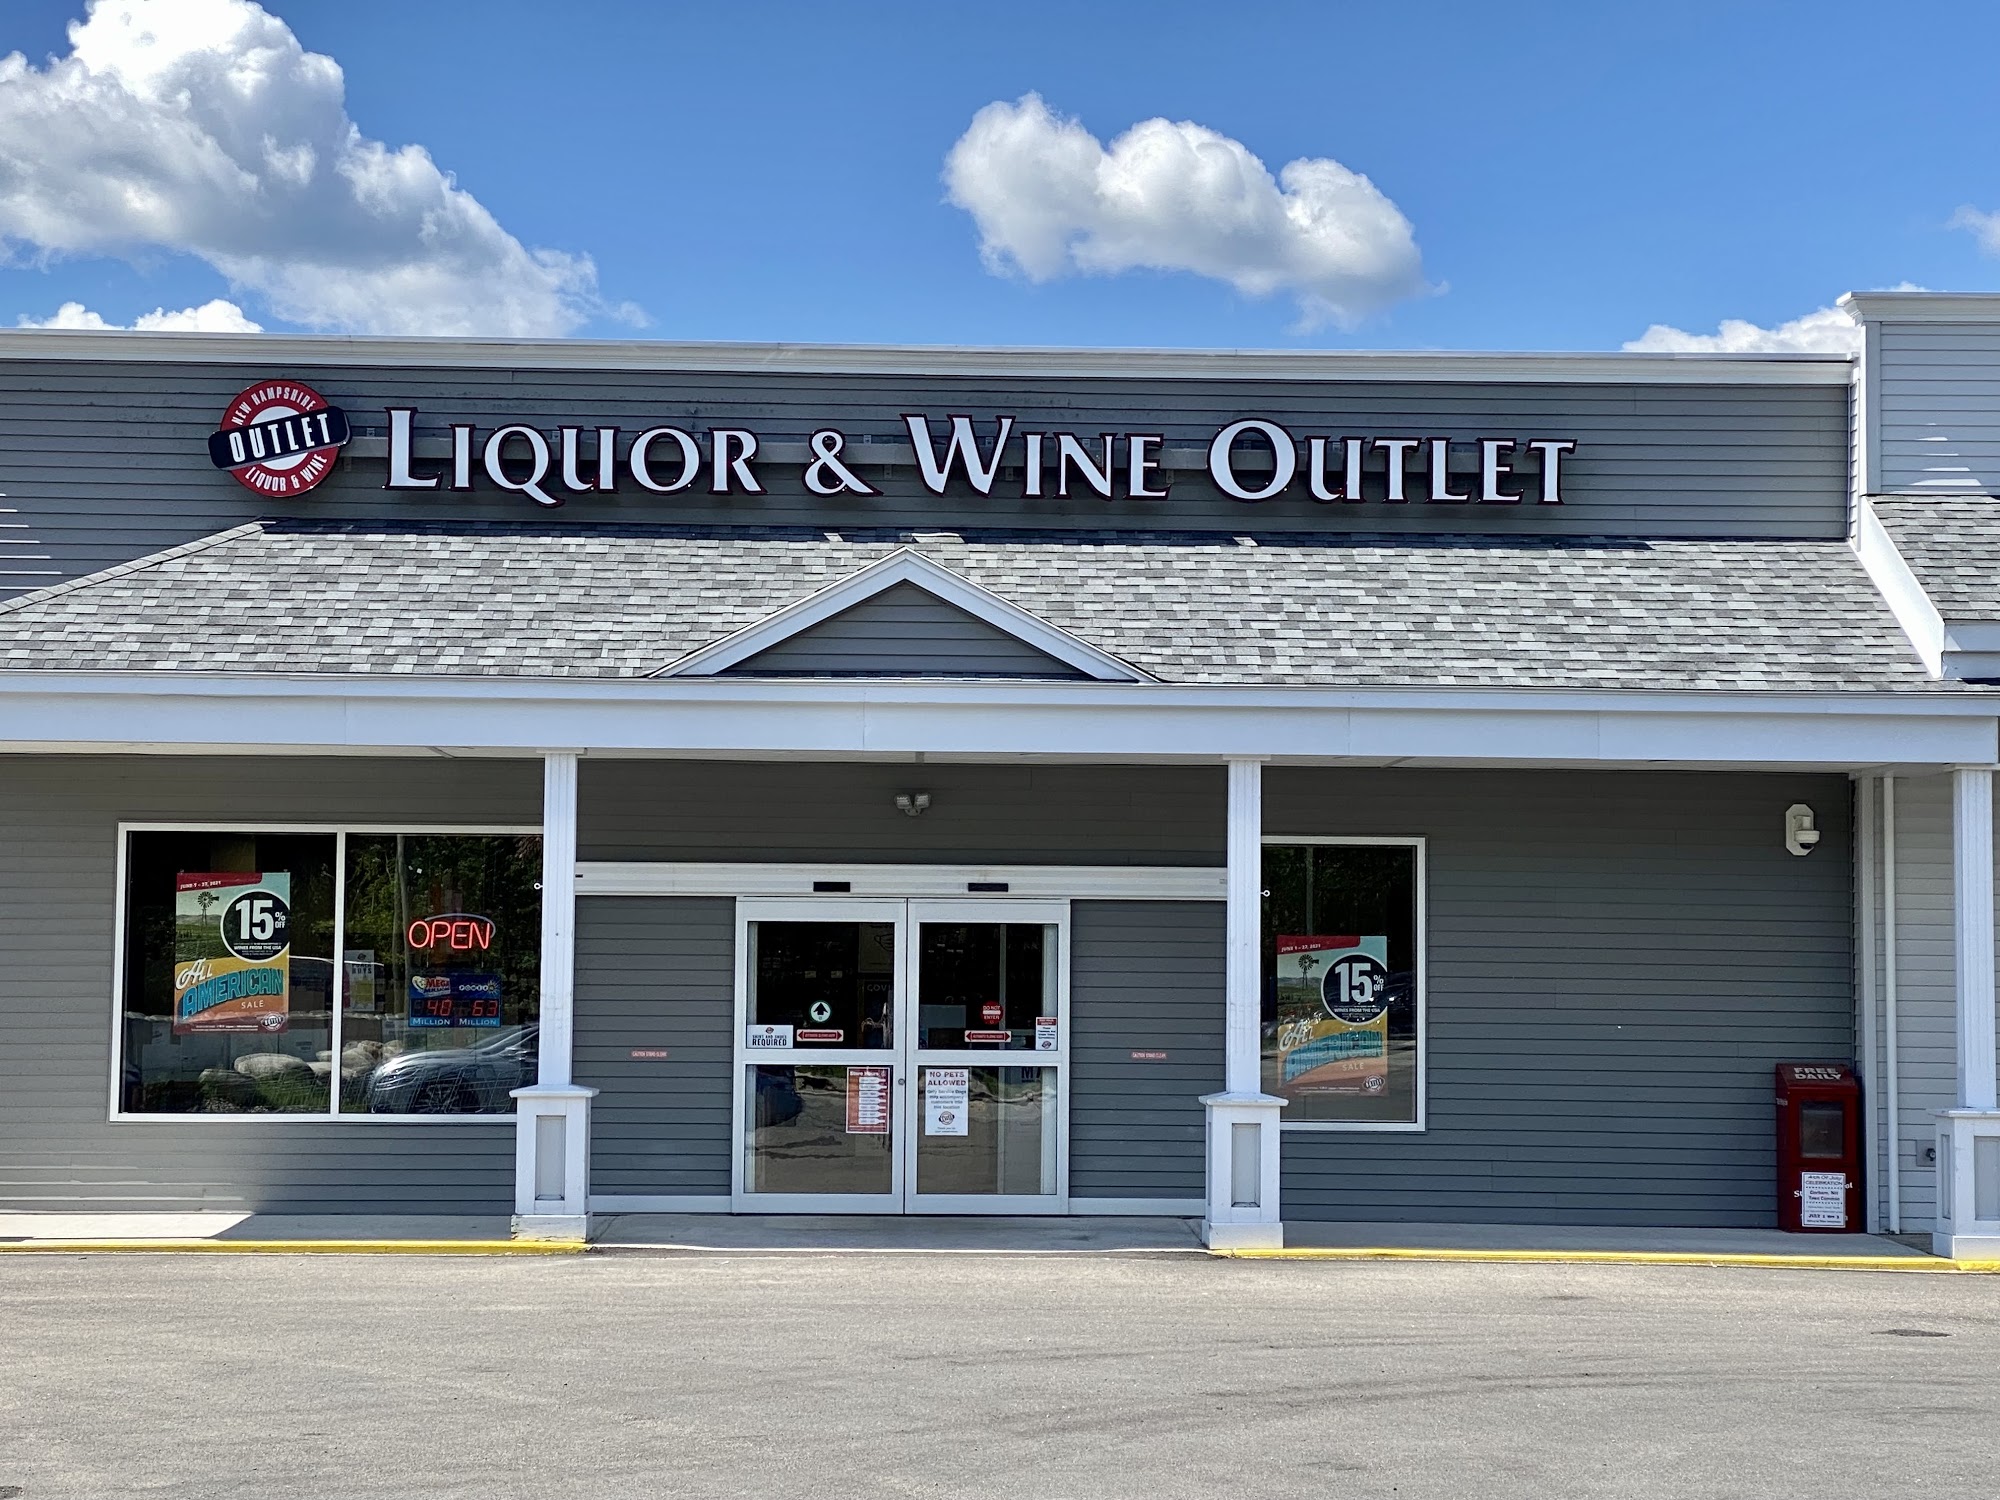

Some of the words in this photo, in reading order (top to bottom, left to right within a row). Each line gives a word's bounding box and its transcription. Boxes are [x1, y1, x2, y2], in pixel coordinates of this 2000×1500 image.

[231, 401, 252, 426] NEW
[251, 386, 317, 411] HAMPSHIRE
[229, 413, 330, 463] OUTLET
[384, 407, 768, 508] LIQUOR
[802, 425, 884, 498] &
[900, 412, 1172, 500] WINE
[1205, 417, 1578, 505] OUTLET
[245, 466, 287, 491] LIQUOR
[290, 474, 300, 489] &
[300, 453, 328, 483] WINE
[235, 899, 274, 940] 15
[274, 911, 286, 921] %
[275, 921, 286, 929] OFF
[408, 920, 491, 949] OPEN
[181, 967, 285, 1021] AMERICAN
[1334, 962, 1372, 1003] 15
[1373, 974, 1384, 984] %
[1373, 984, 1384, 992] OFF
[241, 1000, 264, 1009] SALE
[1342, 1062, 1365, 1072] SALE
